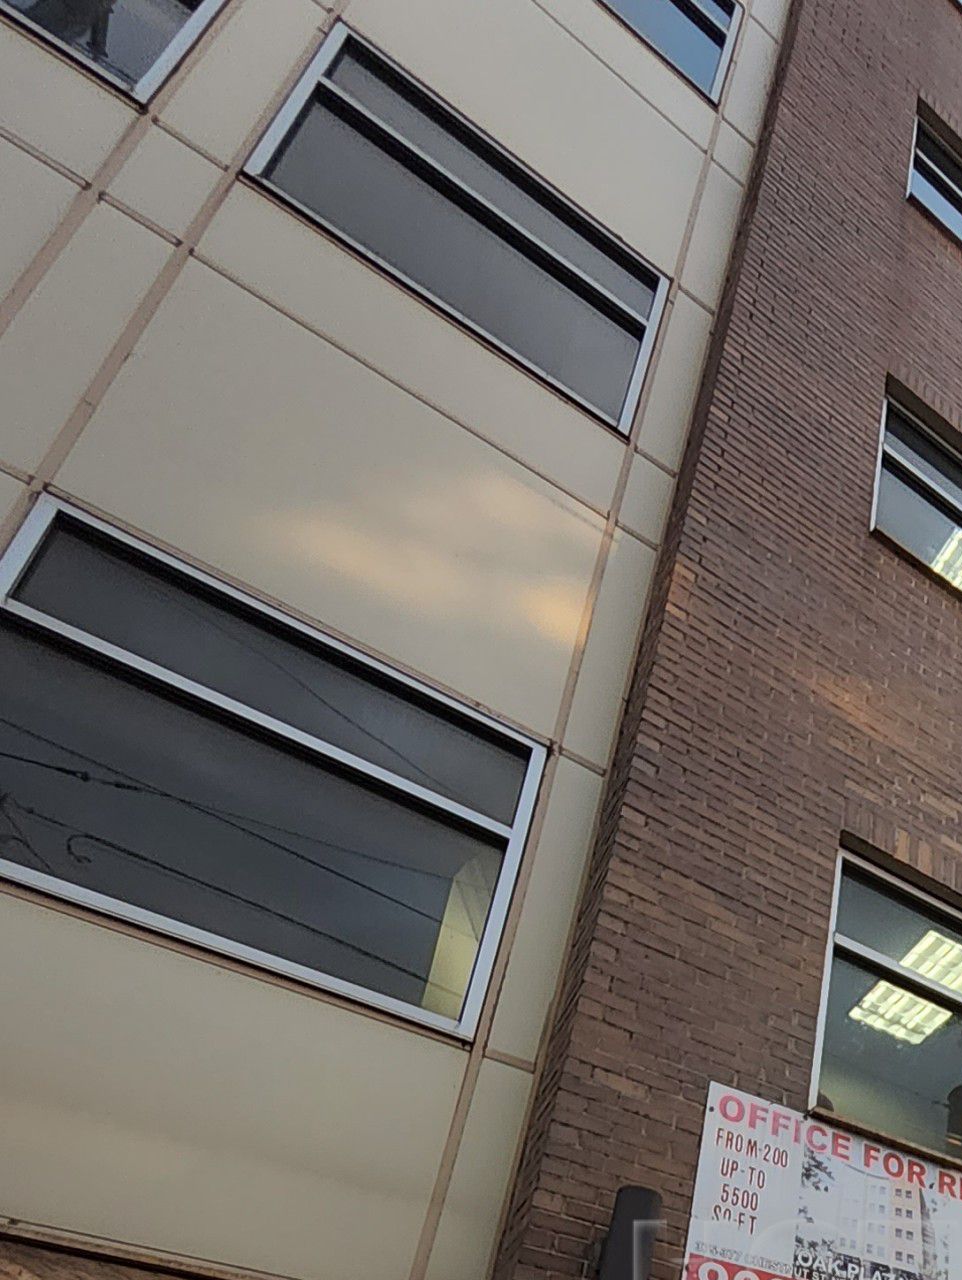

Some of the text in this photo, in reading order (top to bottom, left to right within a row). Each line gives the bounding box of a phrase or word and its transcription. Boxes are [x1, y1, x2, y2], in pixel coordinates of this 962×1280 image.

[719, 1093, 853, 1161] OFFICE
[864, 1143, 926, 1189] FOR
[720, 1157, 766, 1189] UP-TO
[720, 1183, 759, 1211] 5500
[798, 1249, 847, 1278] OAK
